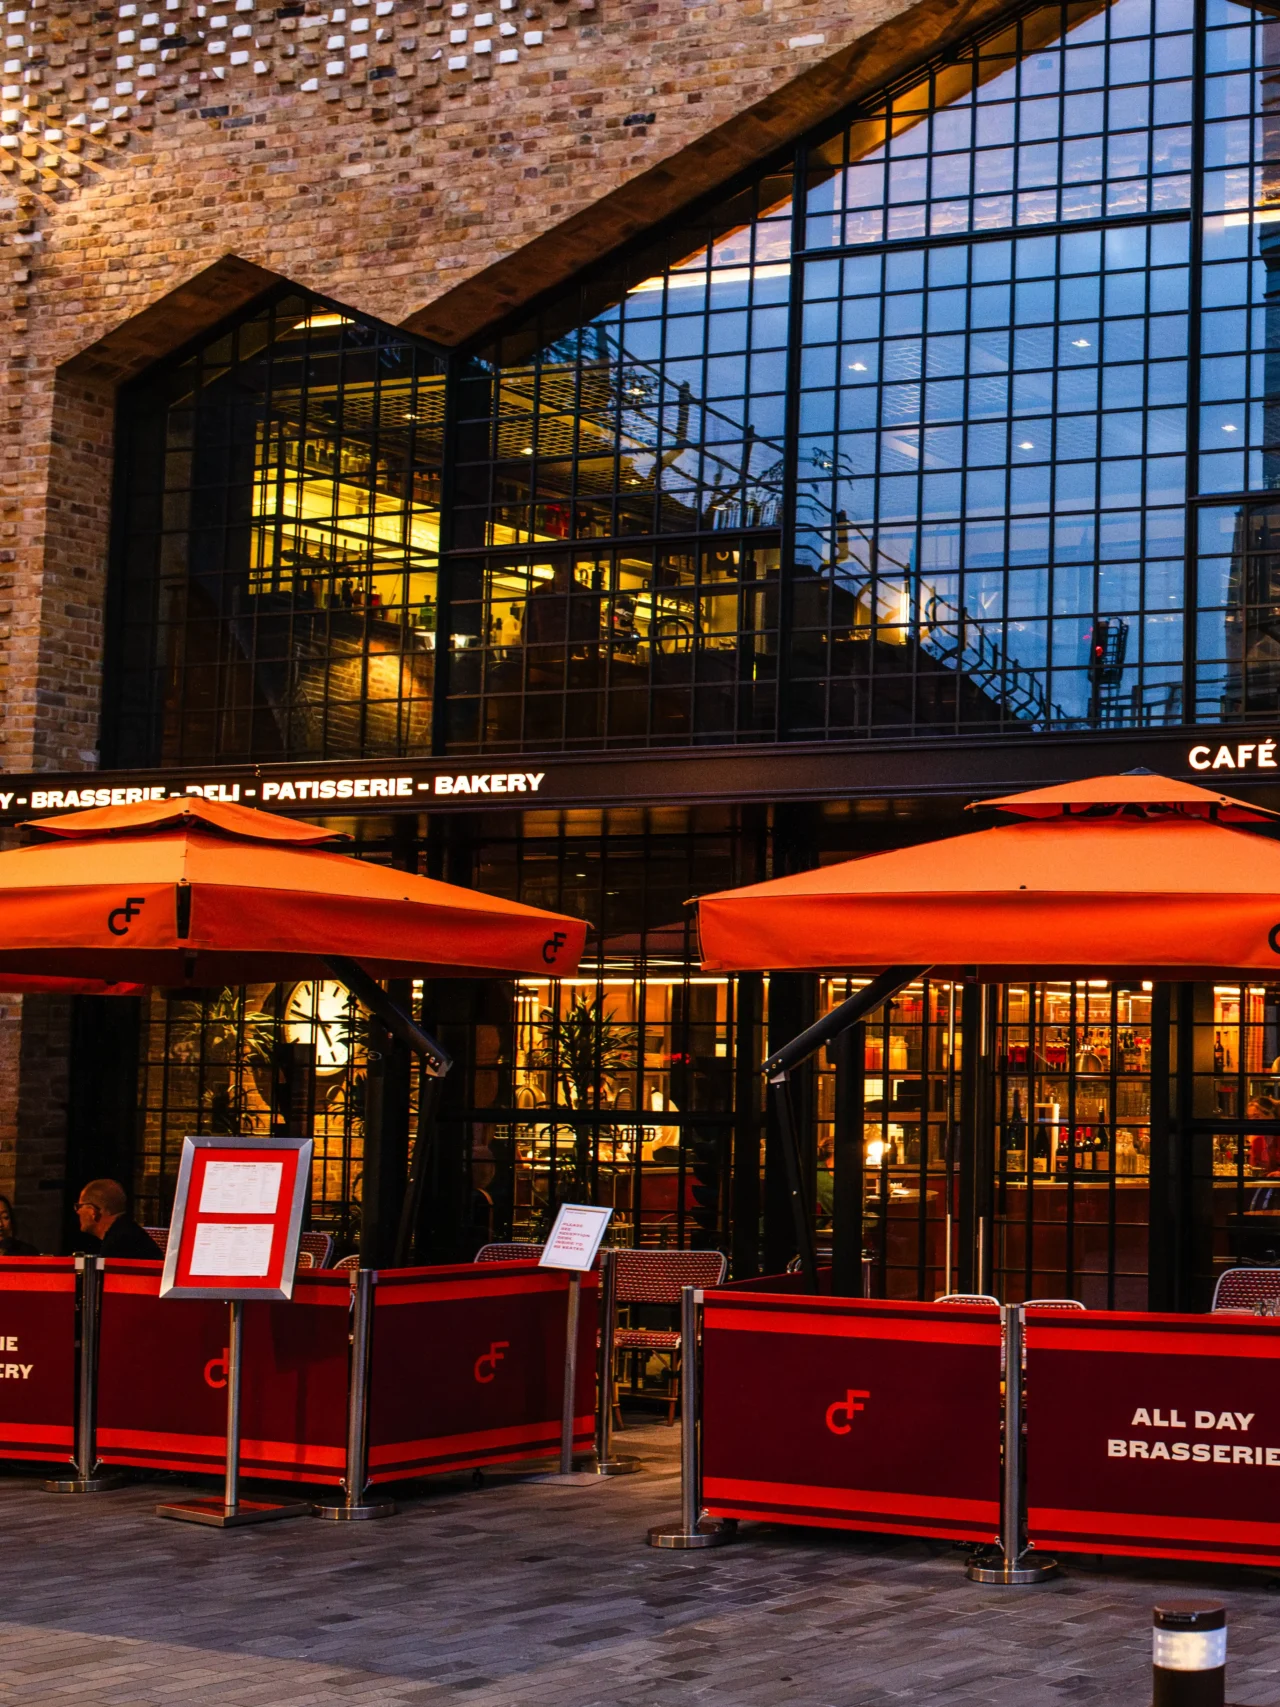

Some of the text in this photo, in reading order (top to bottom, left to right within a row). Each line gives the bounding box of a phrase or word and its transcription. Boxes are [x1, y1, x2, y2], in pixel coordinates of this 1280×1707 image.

[1188, 738, 1278, 770] CAFÉ
[31, 786, 166, 809] BRASSERIE
[262, 777, 413, 801] PATISSERIE
[434, 772, 545, 795] BAKERY
[1131, 1407, 1255, 1431] ALL DAY
